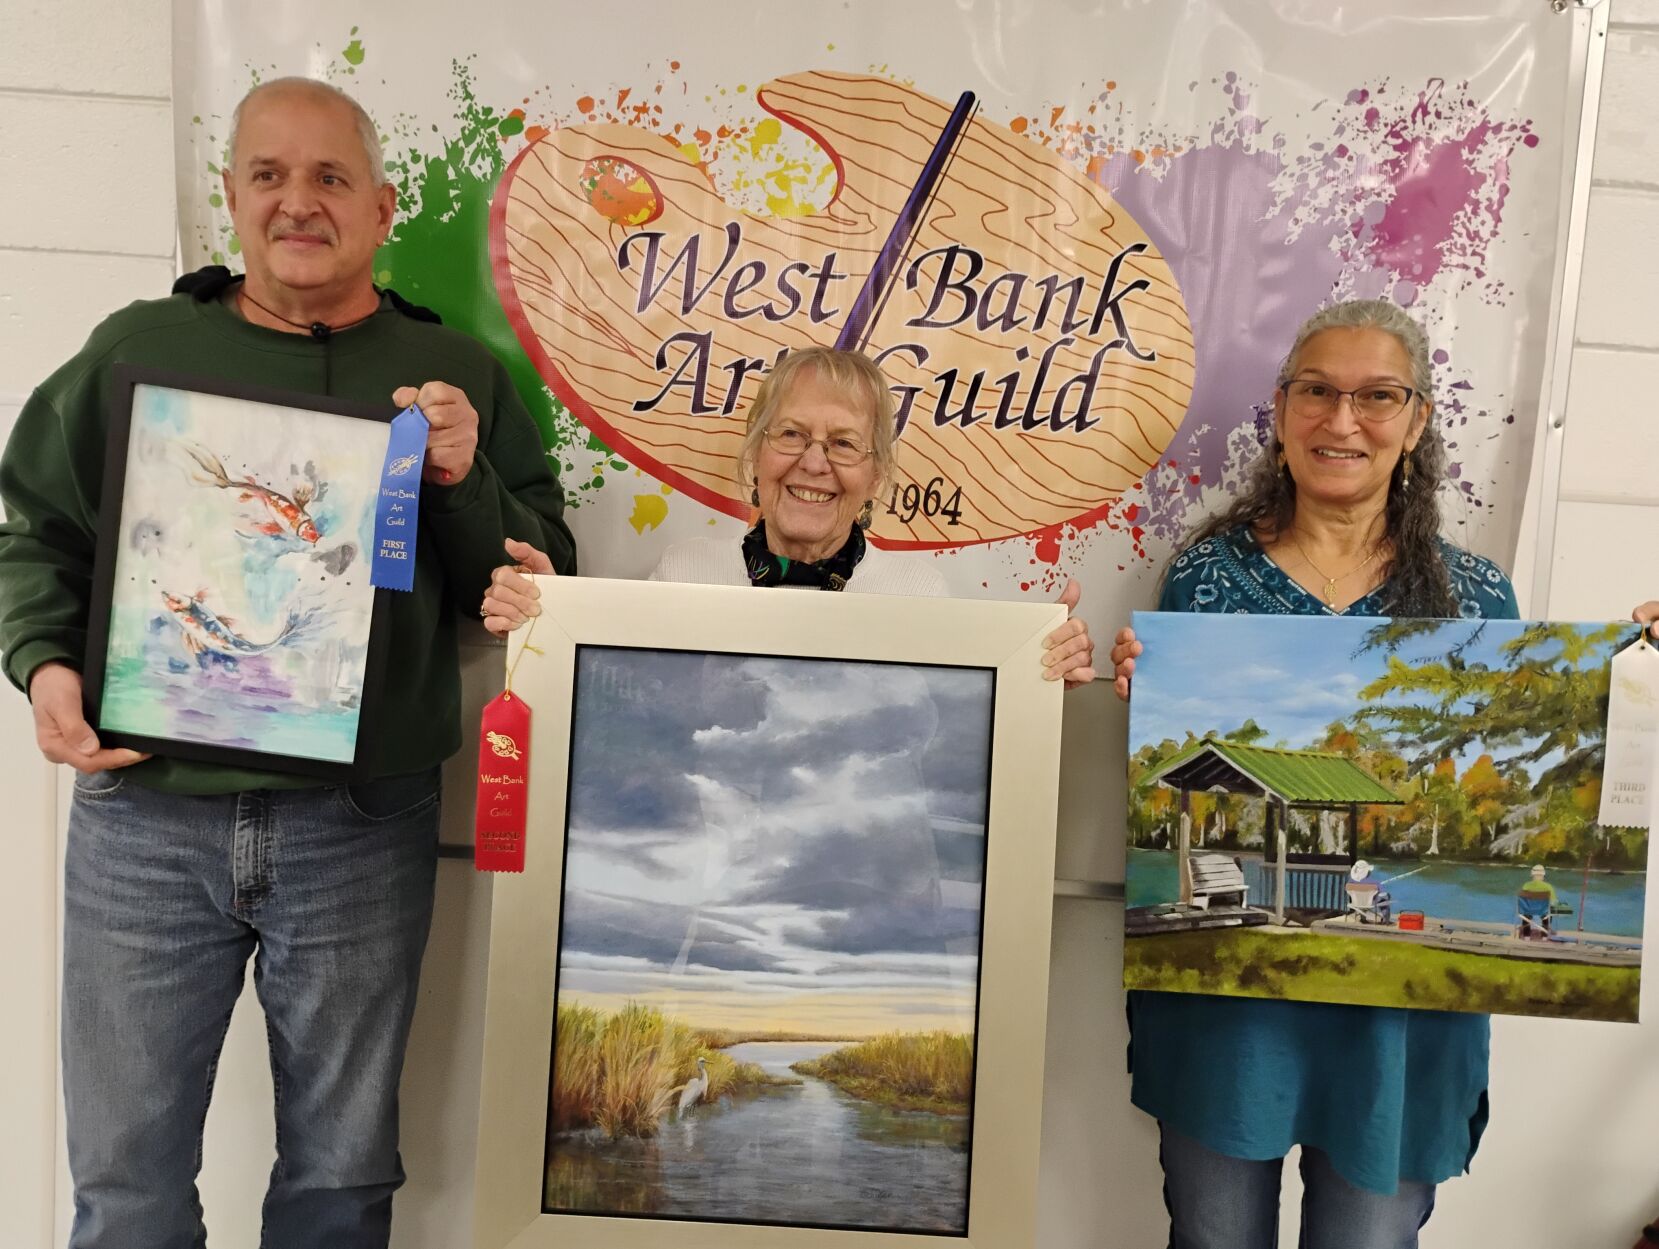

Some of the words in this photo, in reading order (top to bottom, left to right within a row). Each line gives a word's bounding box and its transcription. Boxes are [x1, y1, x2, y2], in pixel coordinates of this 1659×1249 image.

[618, 222, 847, 325] West
[904, 243, 1156, 362] Bank
[873, 337, 1128, 442] Guild
[381, 487, 398, 498] West
[399, 489, 416, 499] Bank
[886, 476, 963, 526] 1964
[390, 503, 403, 512] Art
[386, 516, 405, 526] Guild
[383, 539, 406, 550] FIRST
[380, 549, 408, 560] PLACE
[481, 774, 502, 784] West
[503, 774, 524, 785] Bank
[1613, 782, 1647, 792] THIRD
[494, 791, 510, 801] Art
